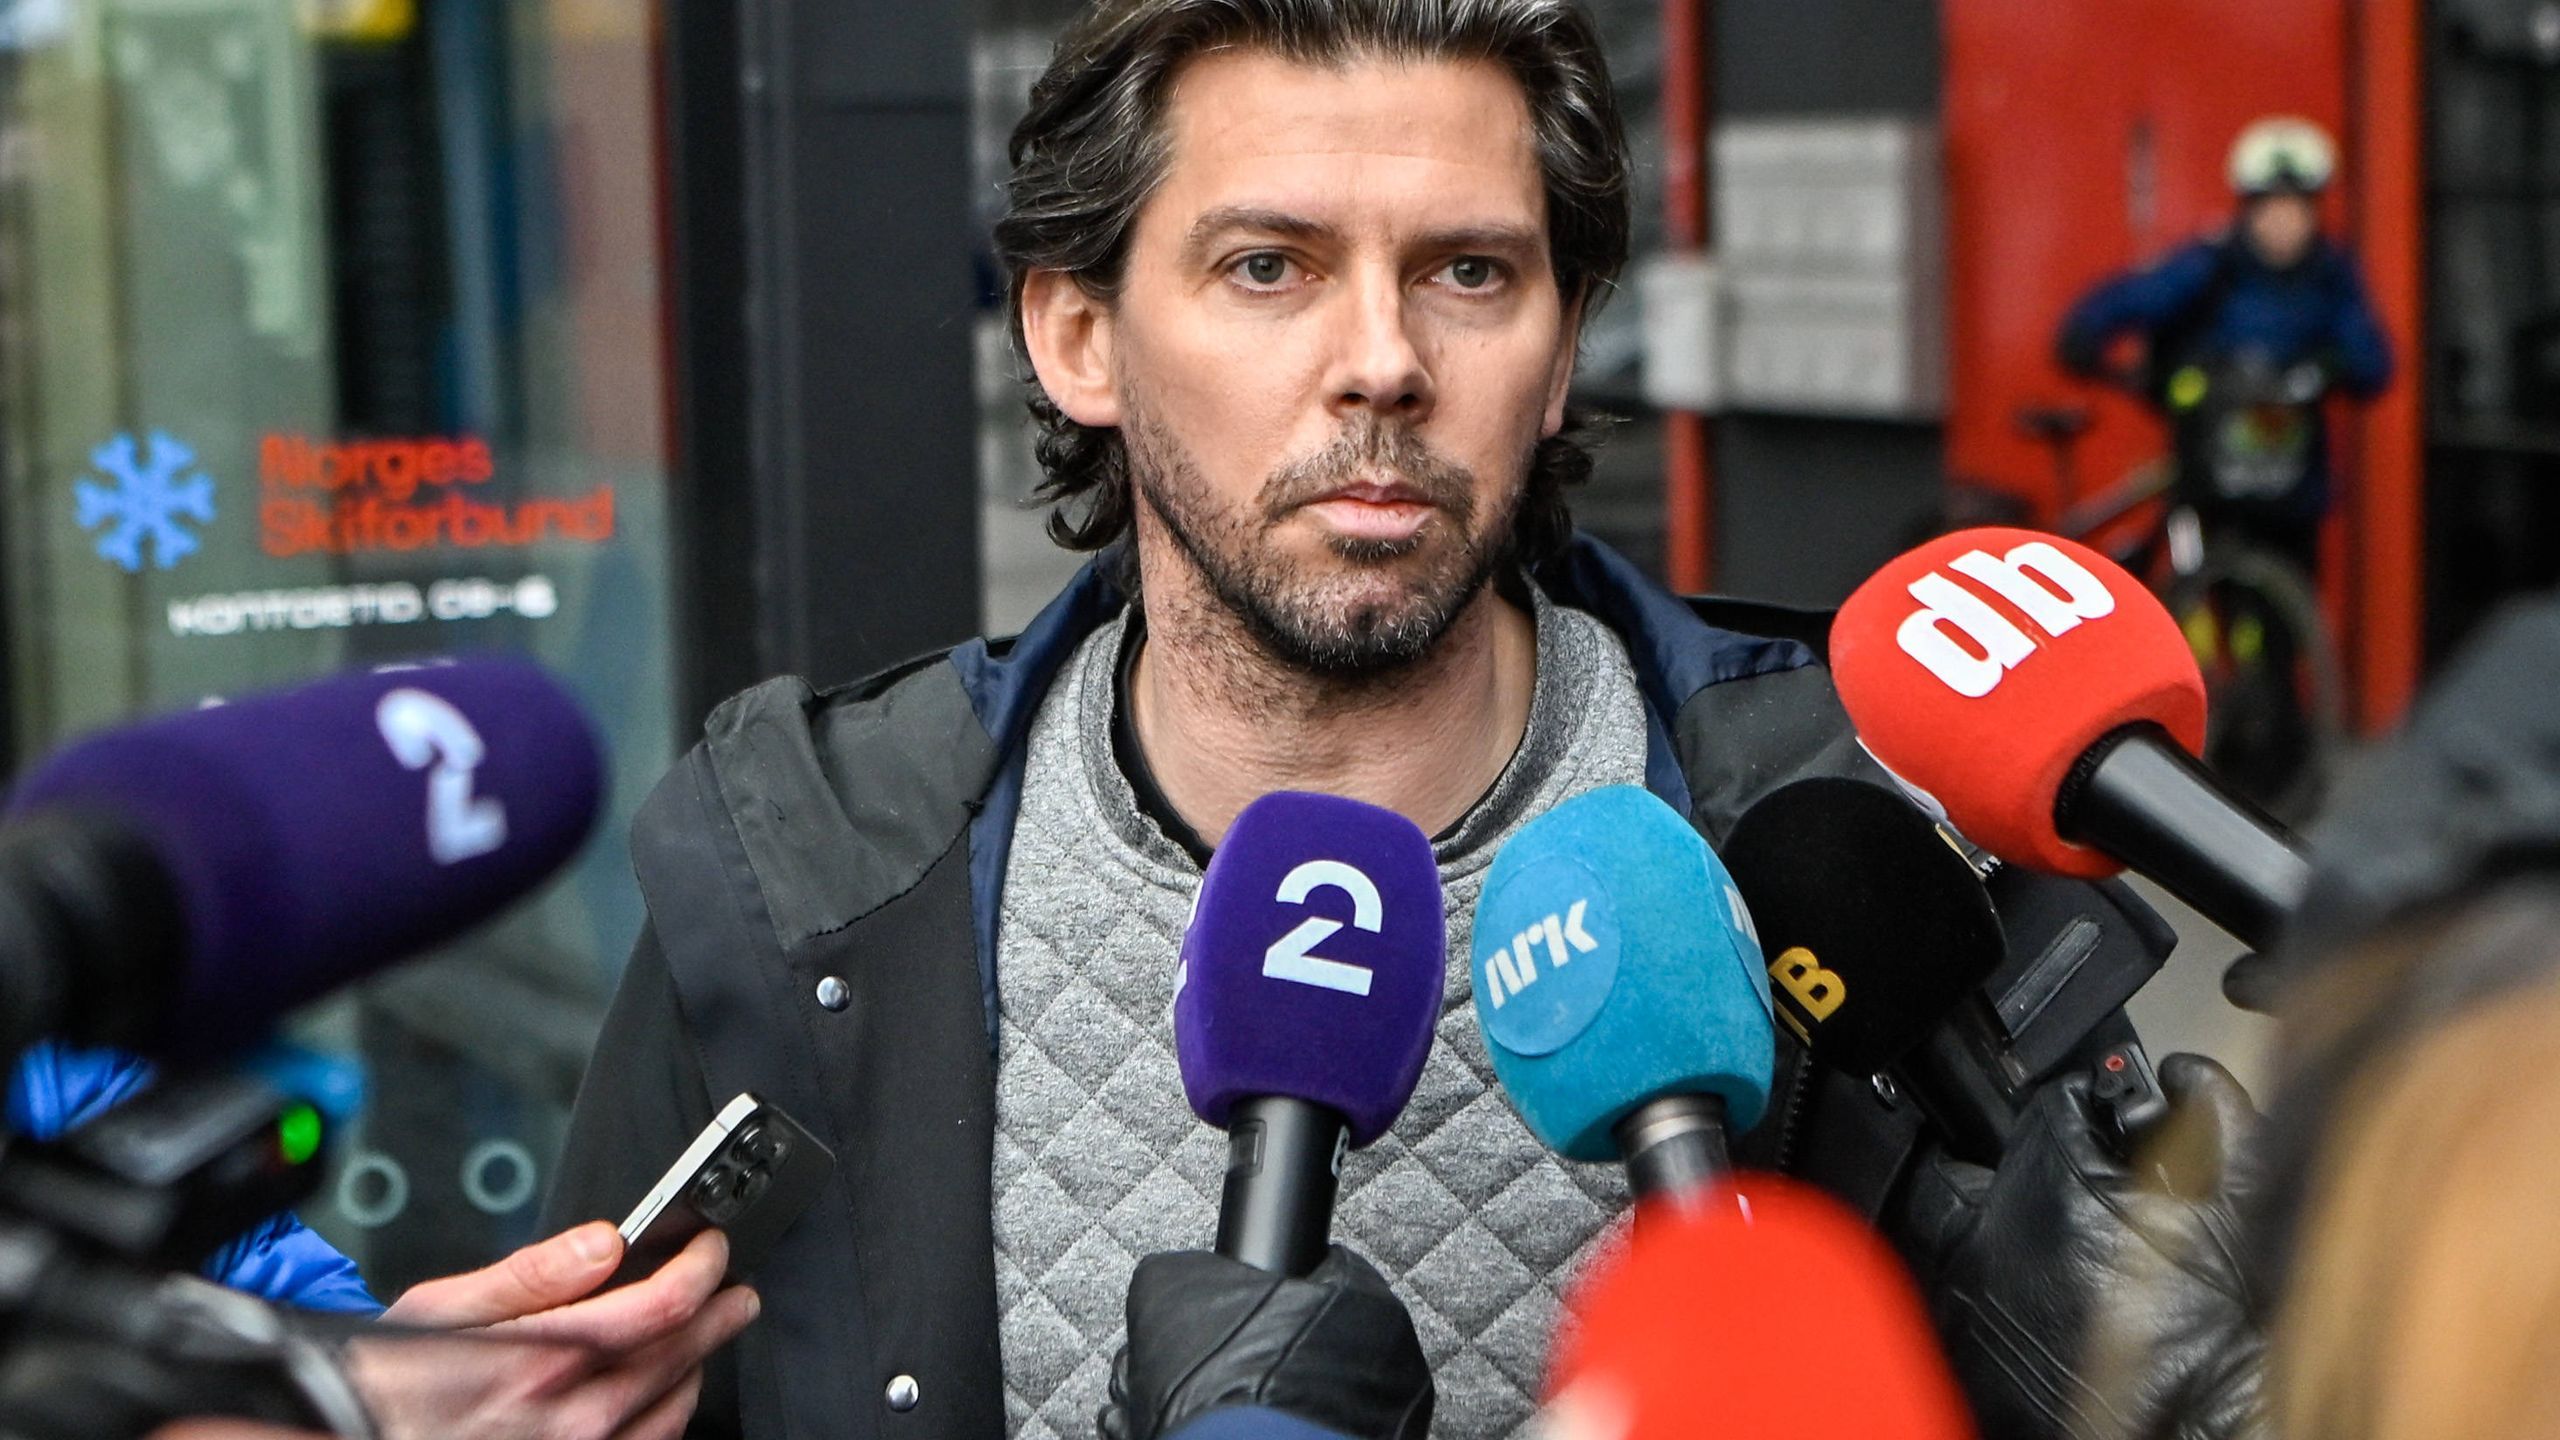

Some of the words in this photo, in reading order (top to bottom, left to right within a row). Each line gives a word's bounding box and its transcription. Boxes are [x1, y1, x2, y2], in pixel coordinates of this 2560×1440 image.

[260, 433, 494, 499] Norges
[260, 485, 614, 557] Skiforbund
[1896, 542, 2115, 697] db
[375, 687, 507, 864] 2
[1262, 860, 1383, 997] 2
[1485, 899, 1598, 1010] NRK
